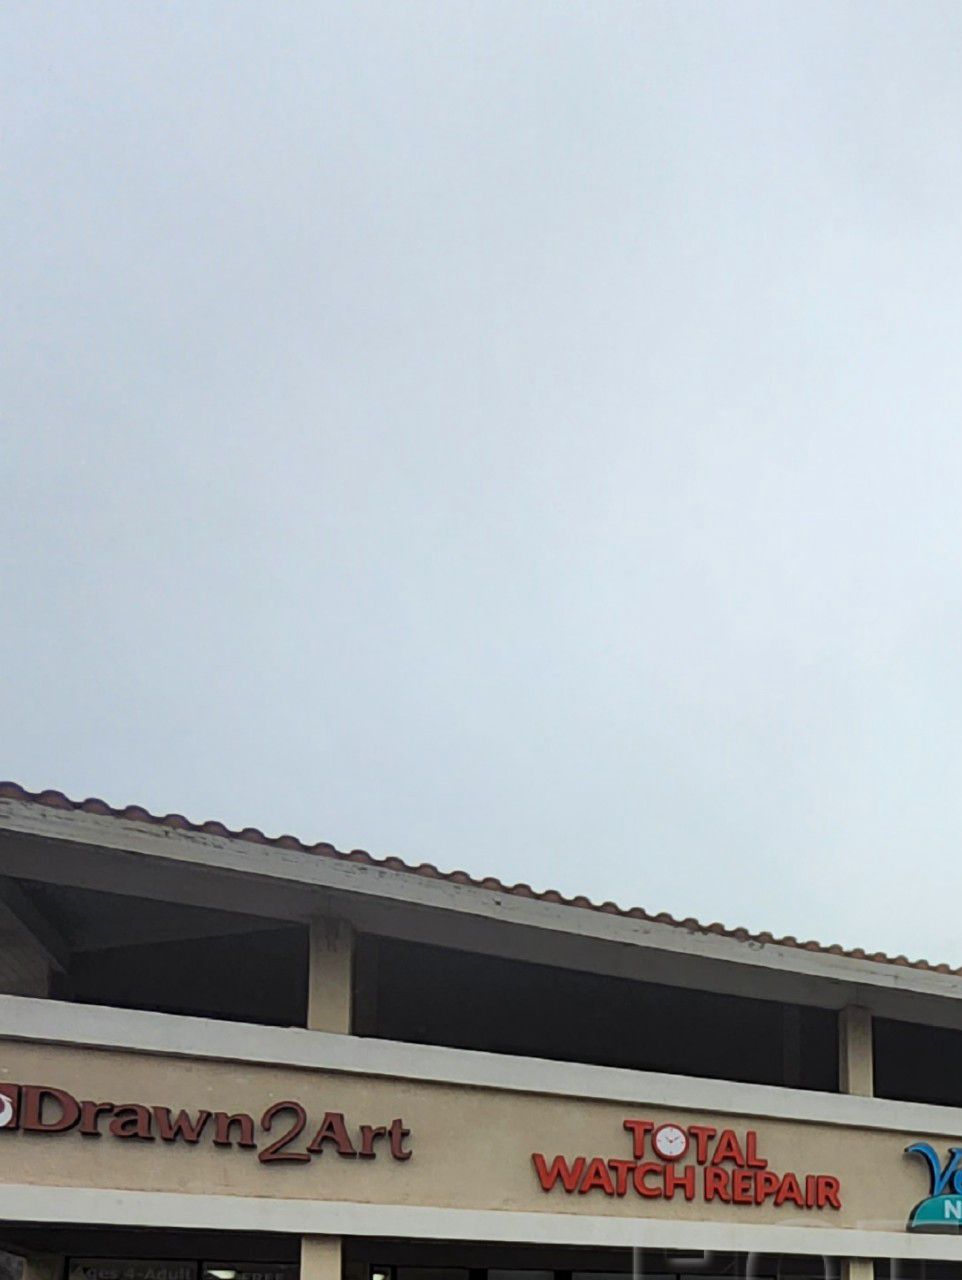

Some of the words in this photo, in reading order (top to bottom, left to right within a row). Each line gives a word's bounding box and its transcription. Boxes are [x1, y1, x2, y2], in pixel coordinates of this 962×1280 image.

[623, 1119, 768, 1169] TOTAL
[531, 1153, 696, 1200] WATCH
[703, 1166, 842, 1209] REPAIR
